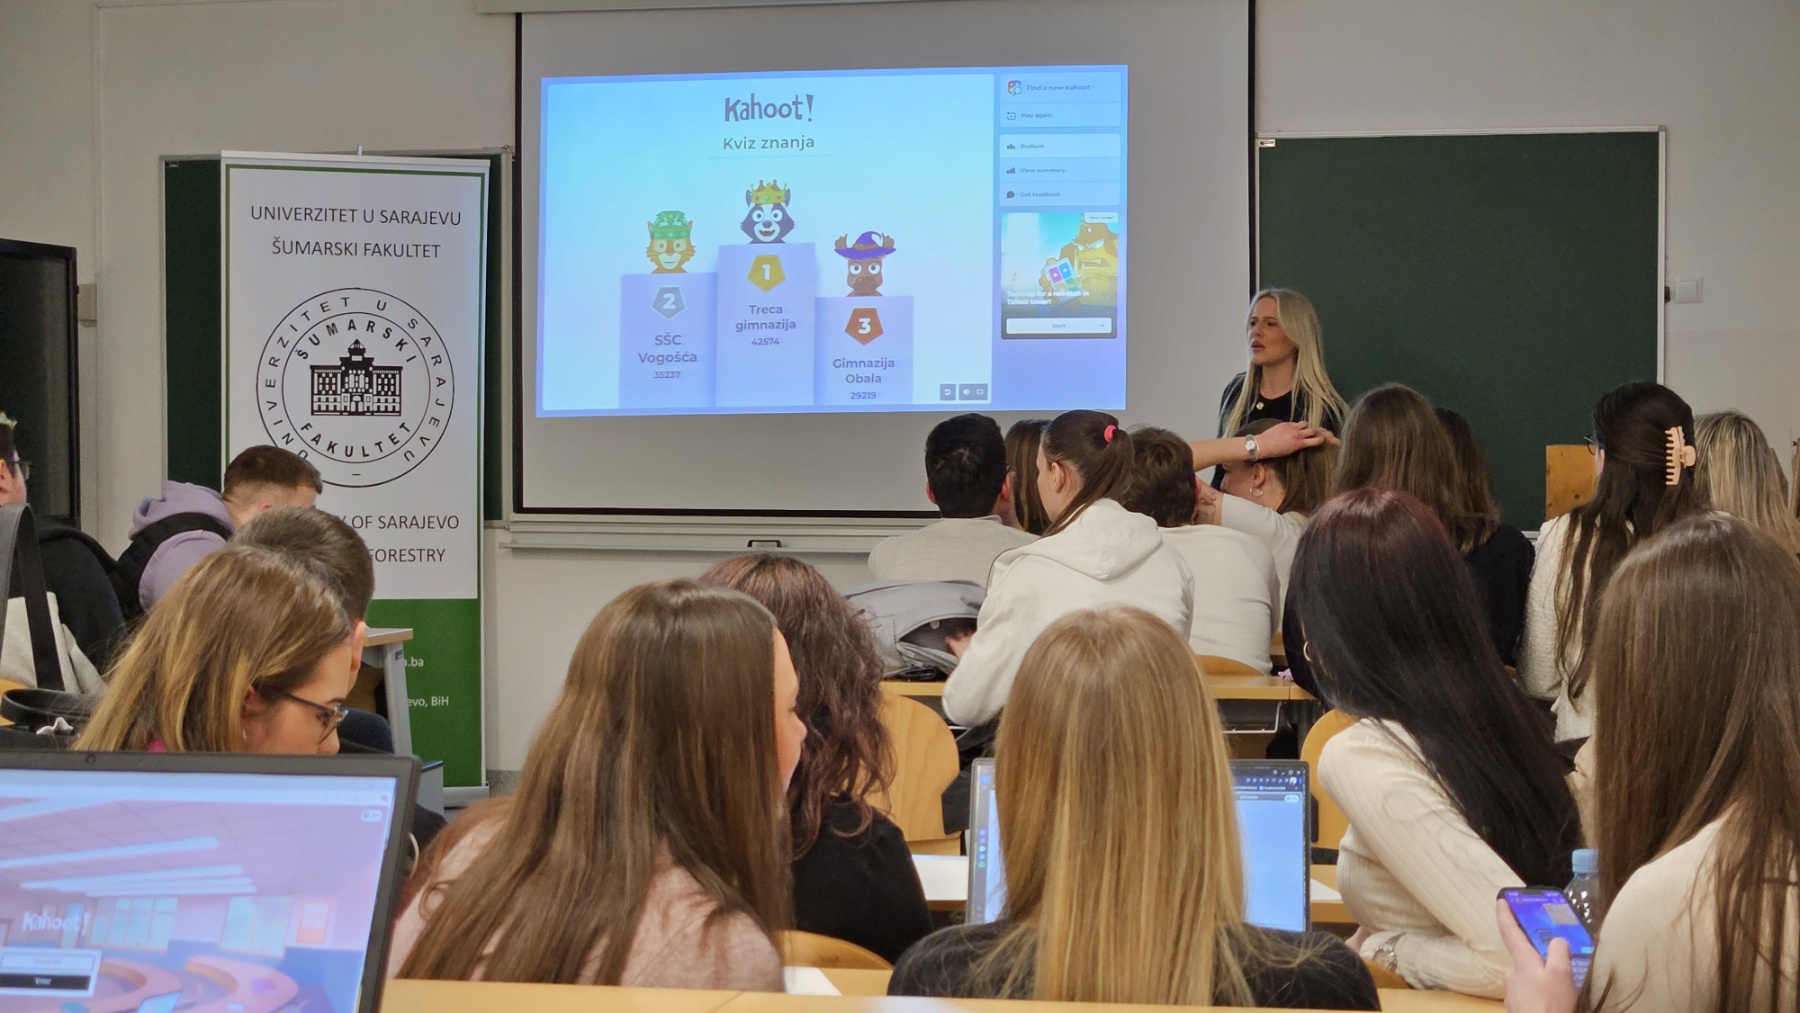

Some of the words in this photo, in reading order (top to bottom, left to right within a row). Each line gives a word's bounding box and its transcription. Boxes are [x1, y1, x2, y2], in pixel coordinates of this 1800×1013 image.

[724, 93, 815, 122] Kahoot!
[723, 135, 757, 151] Kviz
[761, 134, 816, 152] znanja
[250, 204, 358, 224] UNIVERZITET
[362, 208, 375, 224] U
[379, 209, 462, 226] SARAJEVU
[271, 235, 358, 257] ŠUMARSKI
[363, 241, 441, 259] FAKULTET
[762, 263, 772, 281] 1
[662, 293, 676, 310] 2
[748, 302, 783, 315] Treca
[735, 317, 797, 334] gimnazija
[857, 317, 872, 334] 3
[294, 318, 418, 364] ŠUMARSKI
[654, 331, 682, 347] SŠC
[751, 336, 780, 346] 42574
[637, 349, 698, 366] Vogošća
[832, 356, 895, 371] Gimnazija
[376, 299, 387, 312] U
[403, 317, 448, 463] SARAJEVU
[653, 369, 681, 380] 35237
[845, 371, 882, 385] Obala
[849, 390, 877, 400] 29219
[300, 421, 412, 459] FAKULTET
[351, 515, 373, 529] OF
[378, 514, 460, 530] SARAJEVO
[431, 695, 449, 706] BiH
[22, 910, 91, 935] Kahoot!
